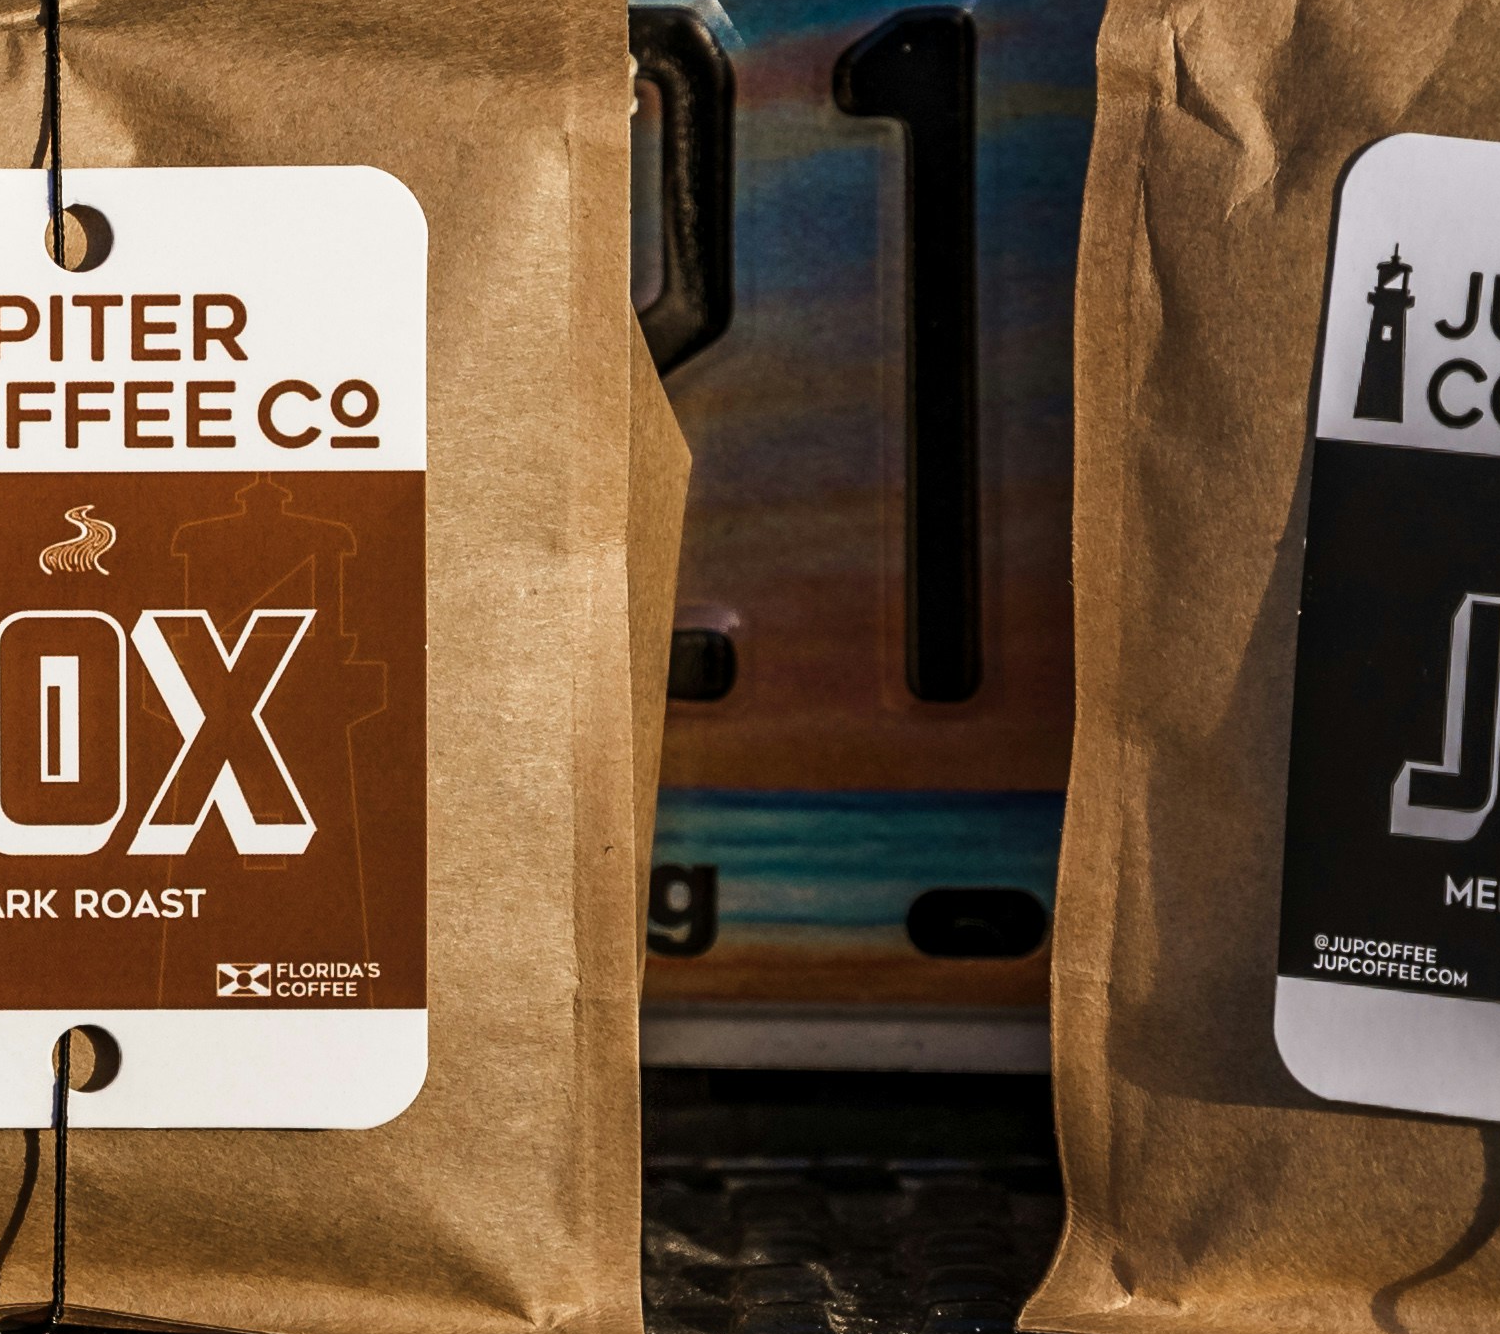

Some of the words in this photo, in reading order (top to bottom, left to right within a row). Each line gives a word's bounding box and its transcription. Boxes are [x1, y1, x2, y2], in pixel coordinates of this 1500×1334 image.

[75, 889, 206, 918] ROAST
[1315, 935, 1436, 963] @JUPCOFFEE
[277, 963, 380, 978] FLORIDA'S
[1314, 955, 1467, 986] JUPCOFFEE.COM
[277, 982, 357, 997] COFFEE
